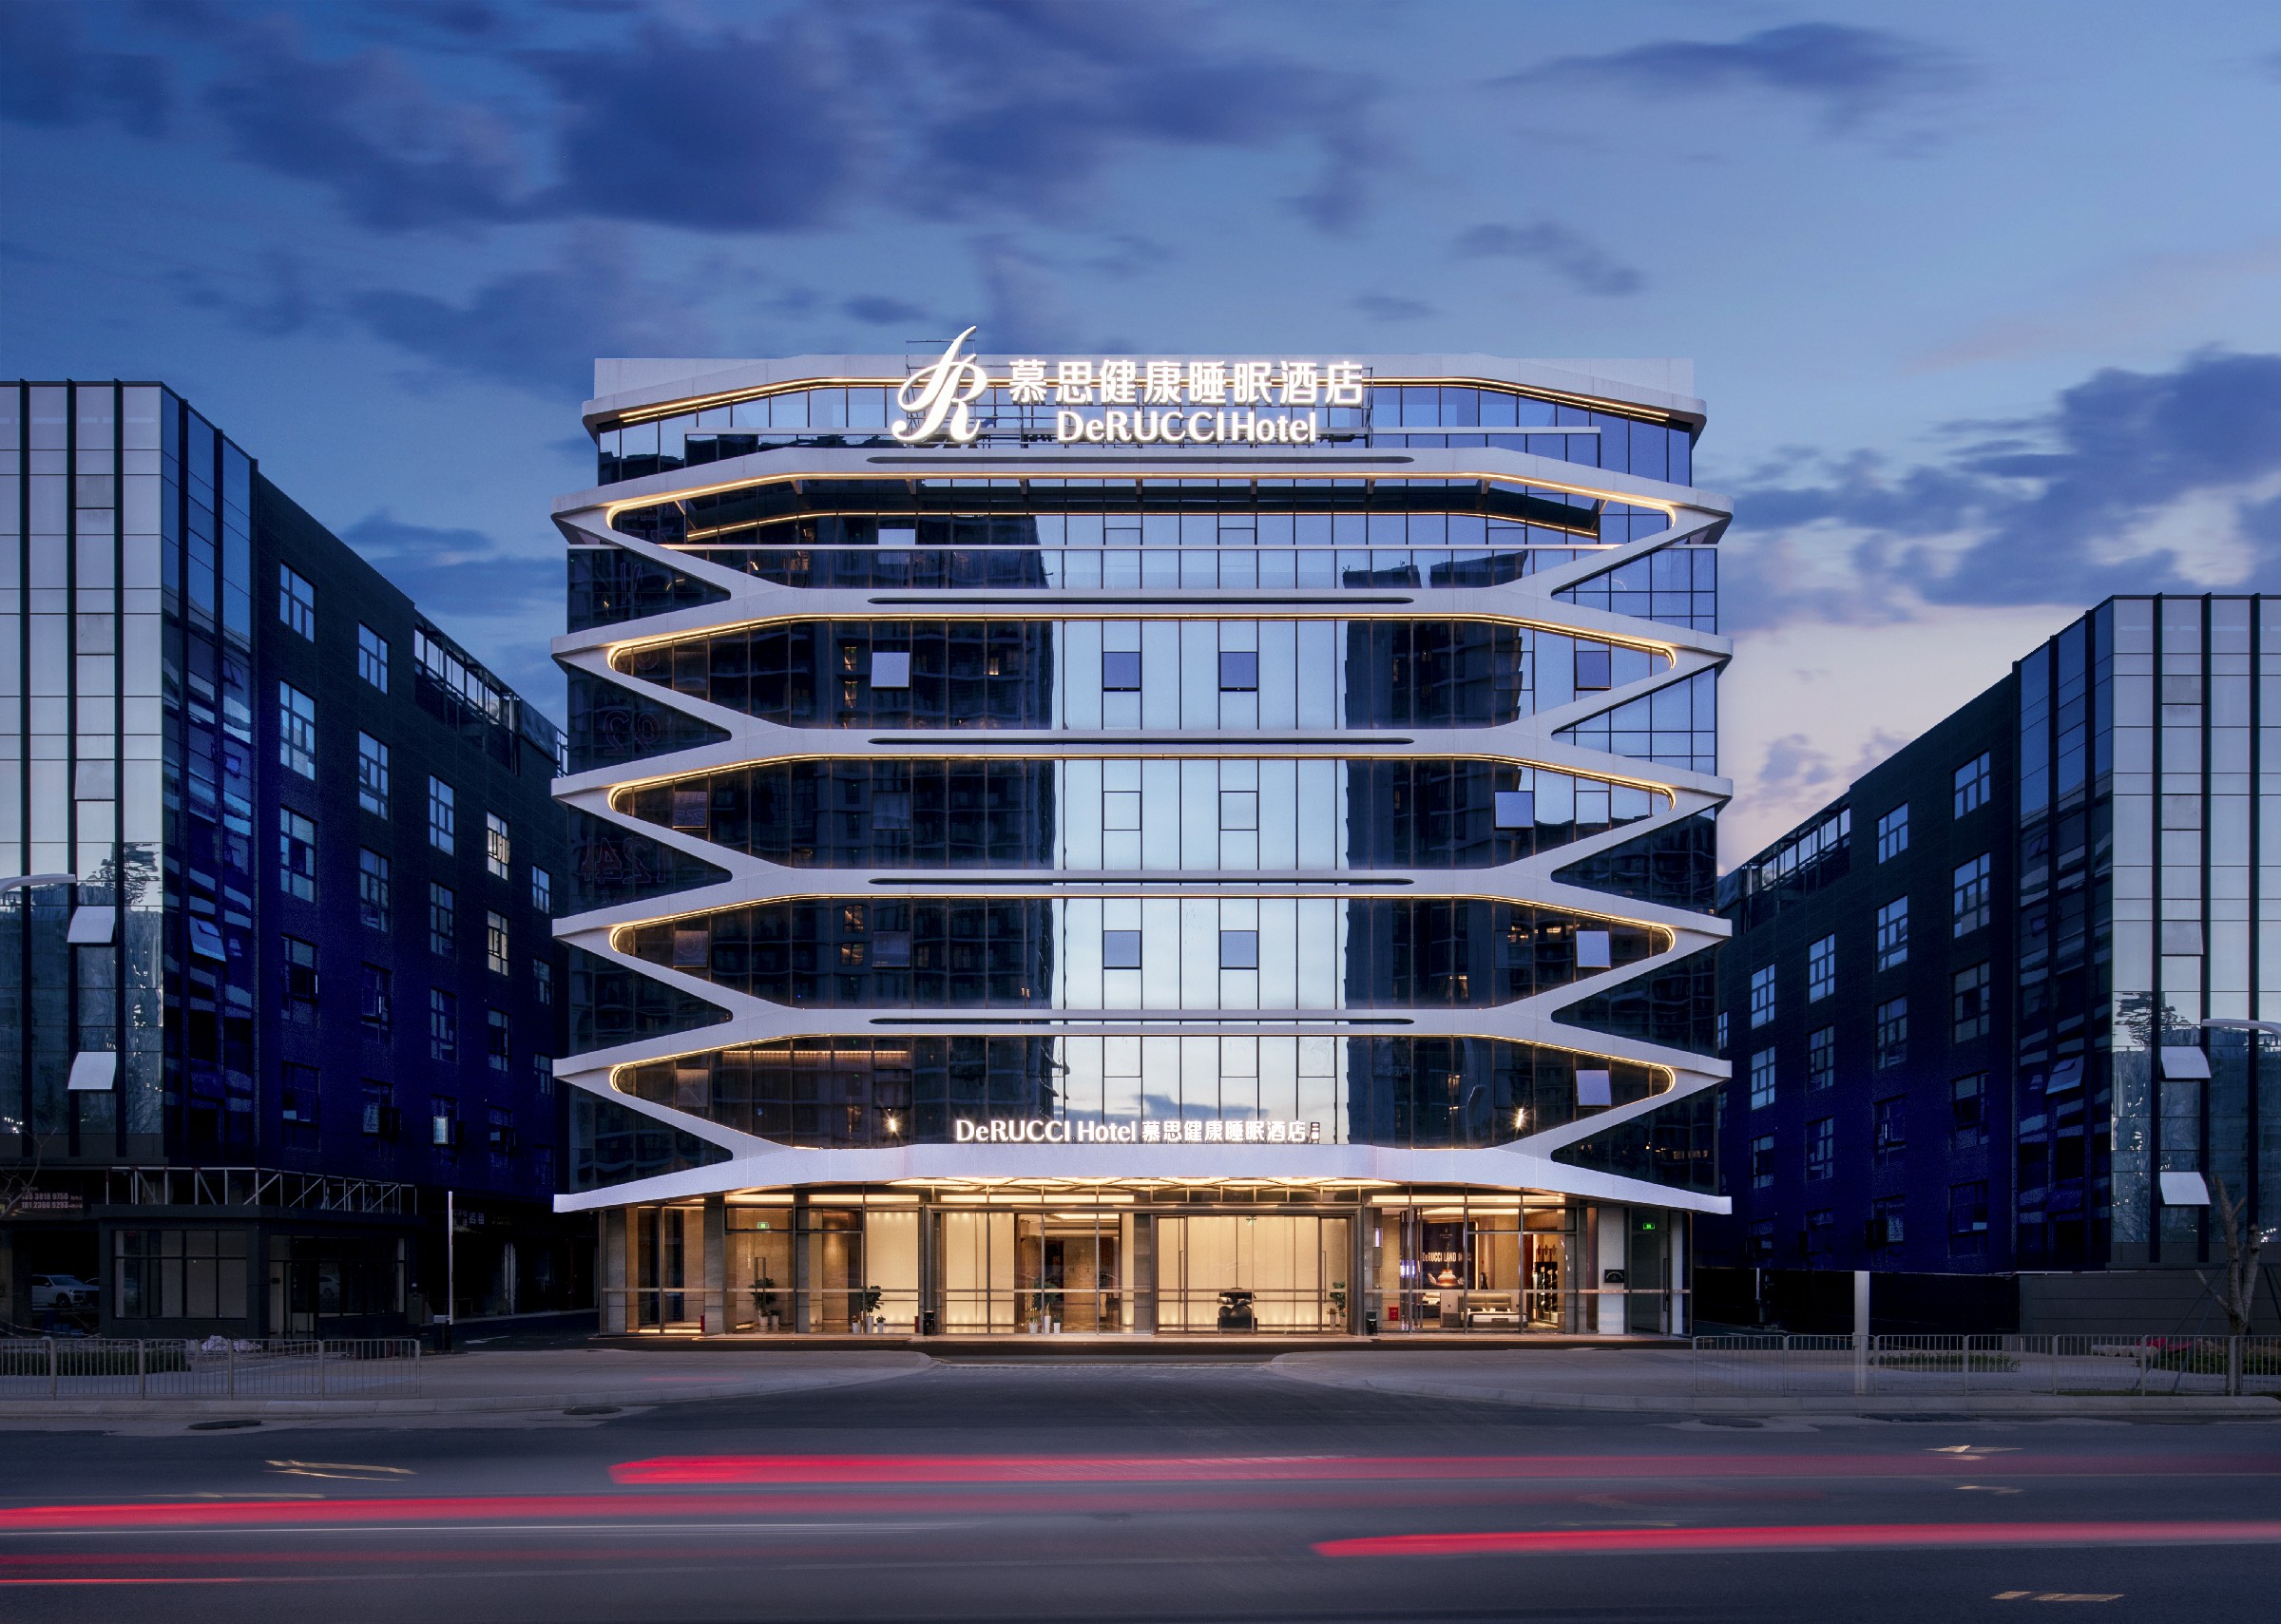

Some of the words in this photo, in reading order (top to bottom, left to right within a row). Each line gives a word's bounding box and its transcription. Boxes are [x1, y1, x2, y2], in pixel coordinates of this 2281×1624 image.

[1009, 358, 1364, 405] 慕思健康睡眠酒店
[1057, 411, 1225, 443] DeRUCCI
[1232, 411, 1317, 443] Hotel
[956, 1119, 1070, 1142] DeRUCCI
[1078, 1119, 1137, 1142] Hotel
[1141, 1119, 1307, 1142] 慕思健康睡眠酒店
